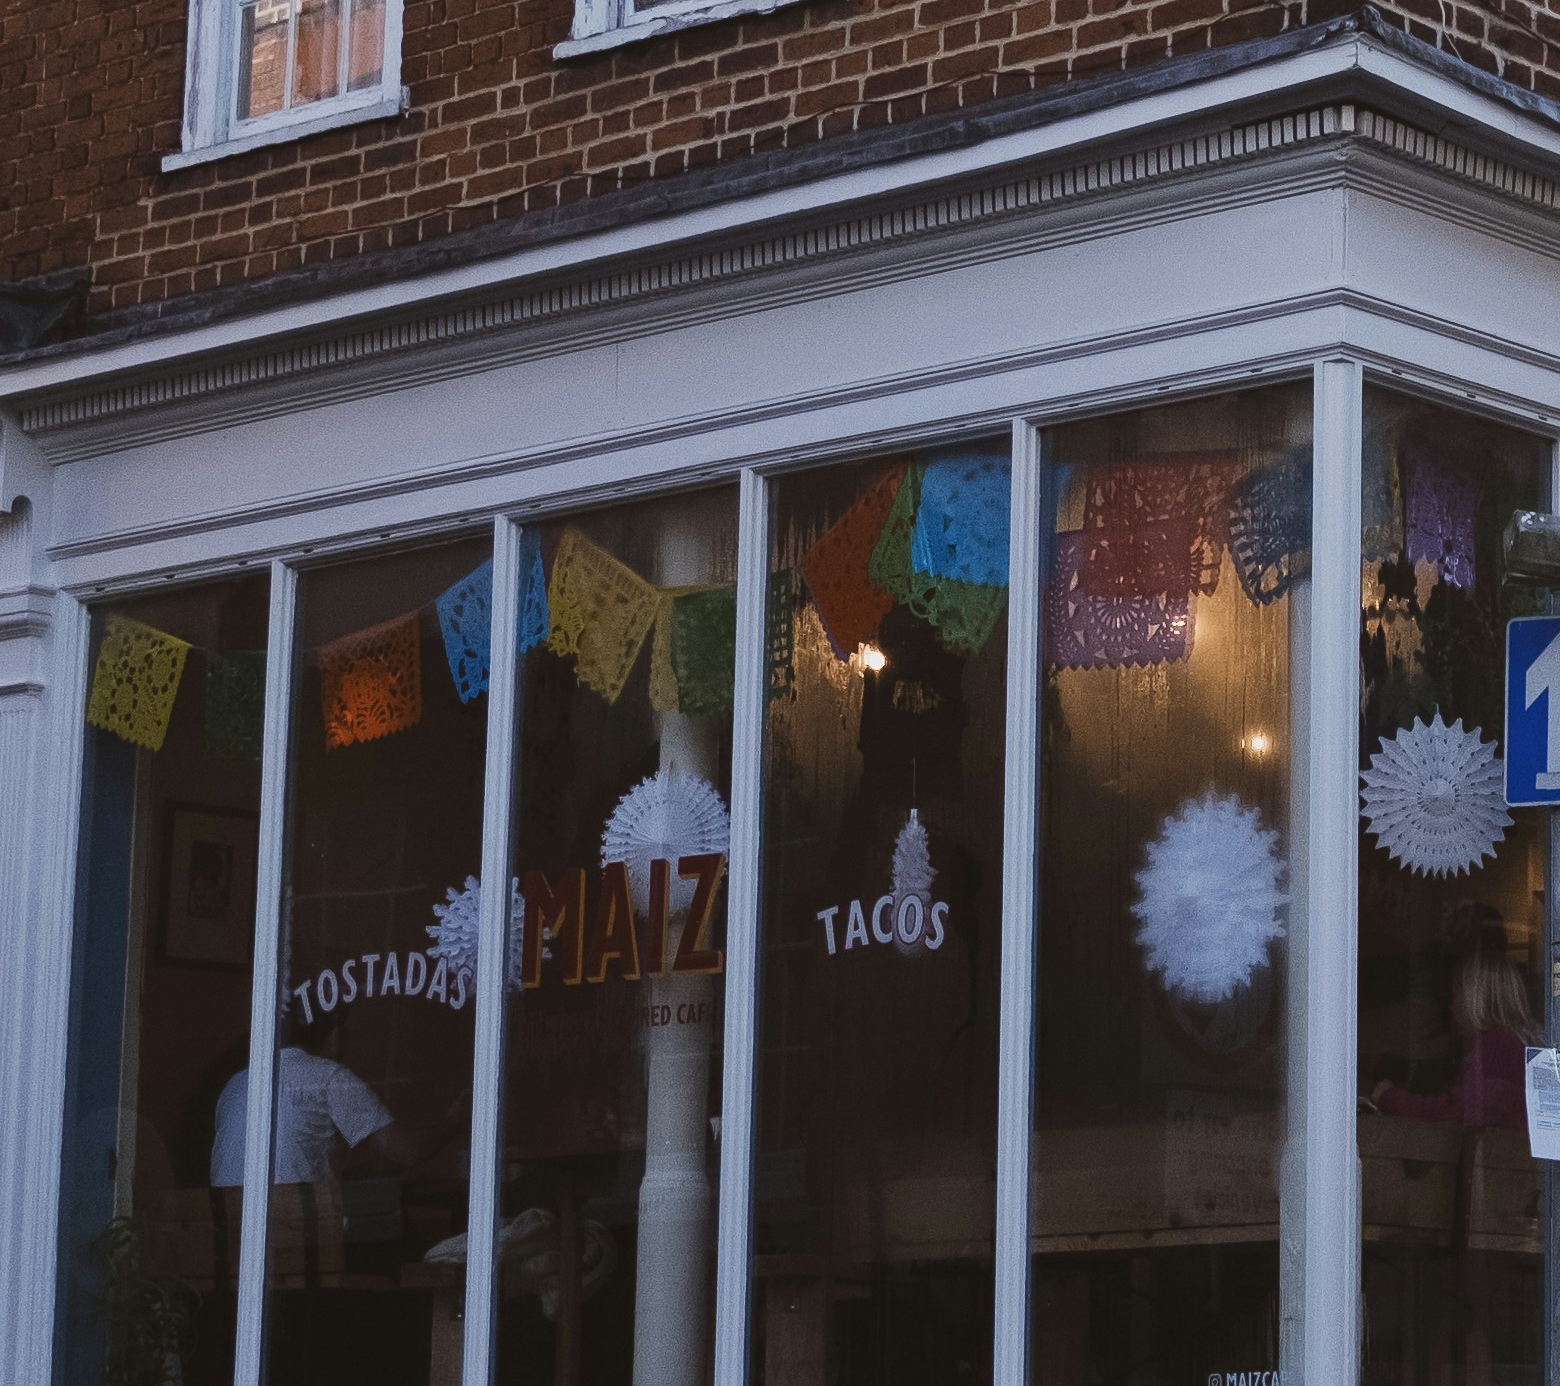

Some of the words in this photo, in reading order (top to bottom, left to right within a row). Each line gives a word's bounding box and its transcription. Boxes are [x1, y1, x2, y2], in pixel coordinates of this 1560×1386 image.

[521, 853, 727, 989] MAIZ
[816, 893, 950, 956] TACOS
[293, 951, 474, 1025] TOSTADAS
[676, 1003, 713, 1026] CAF
